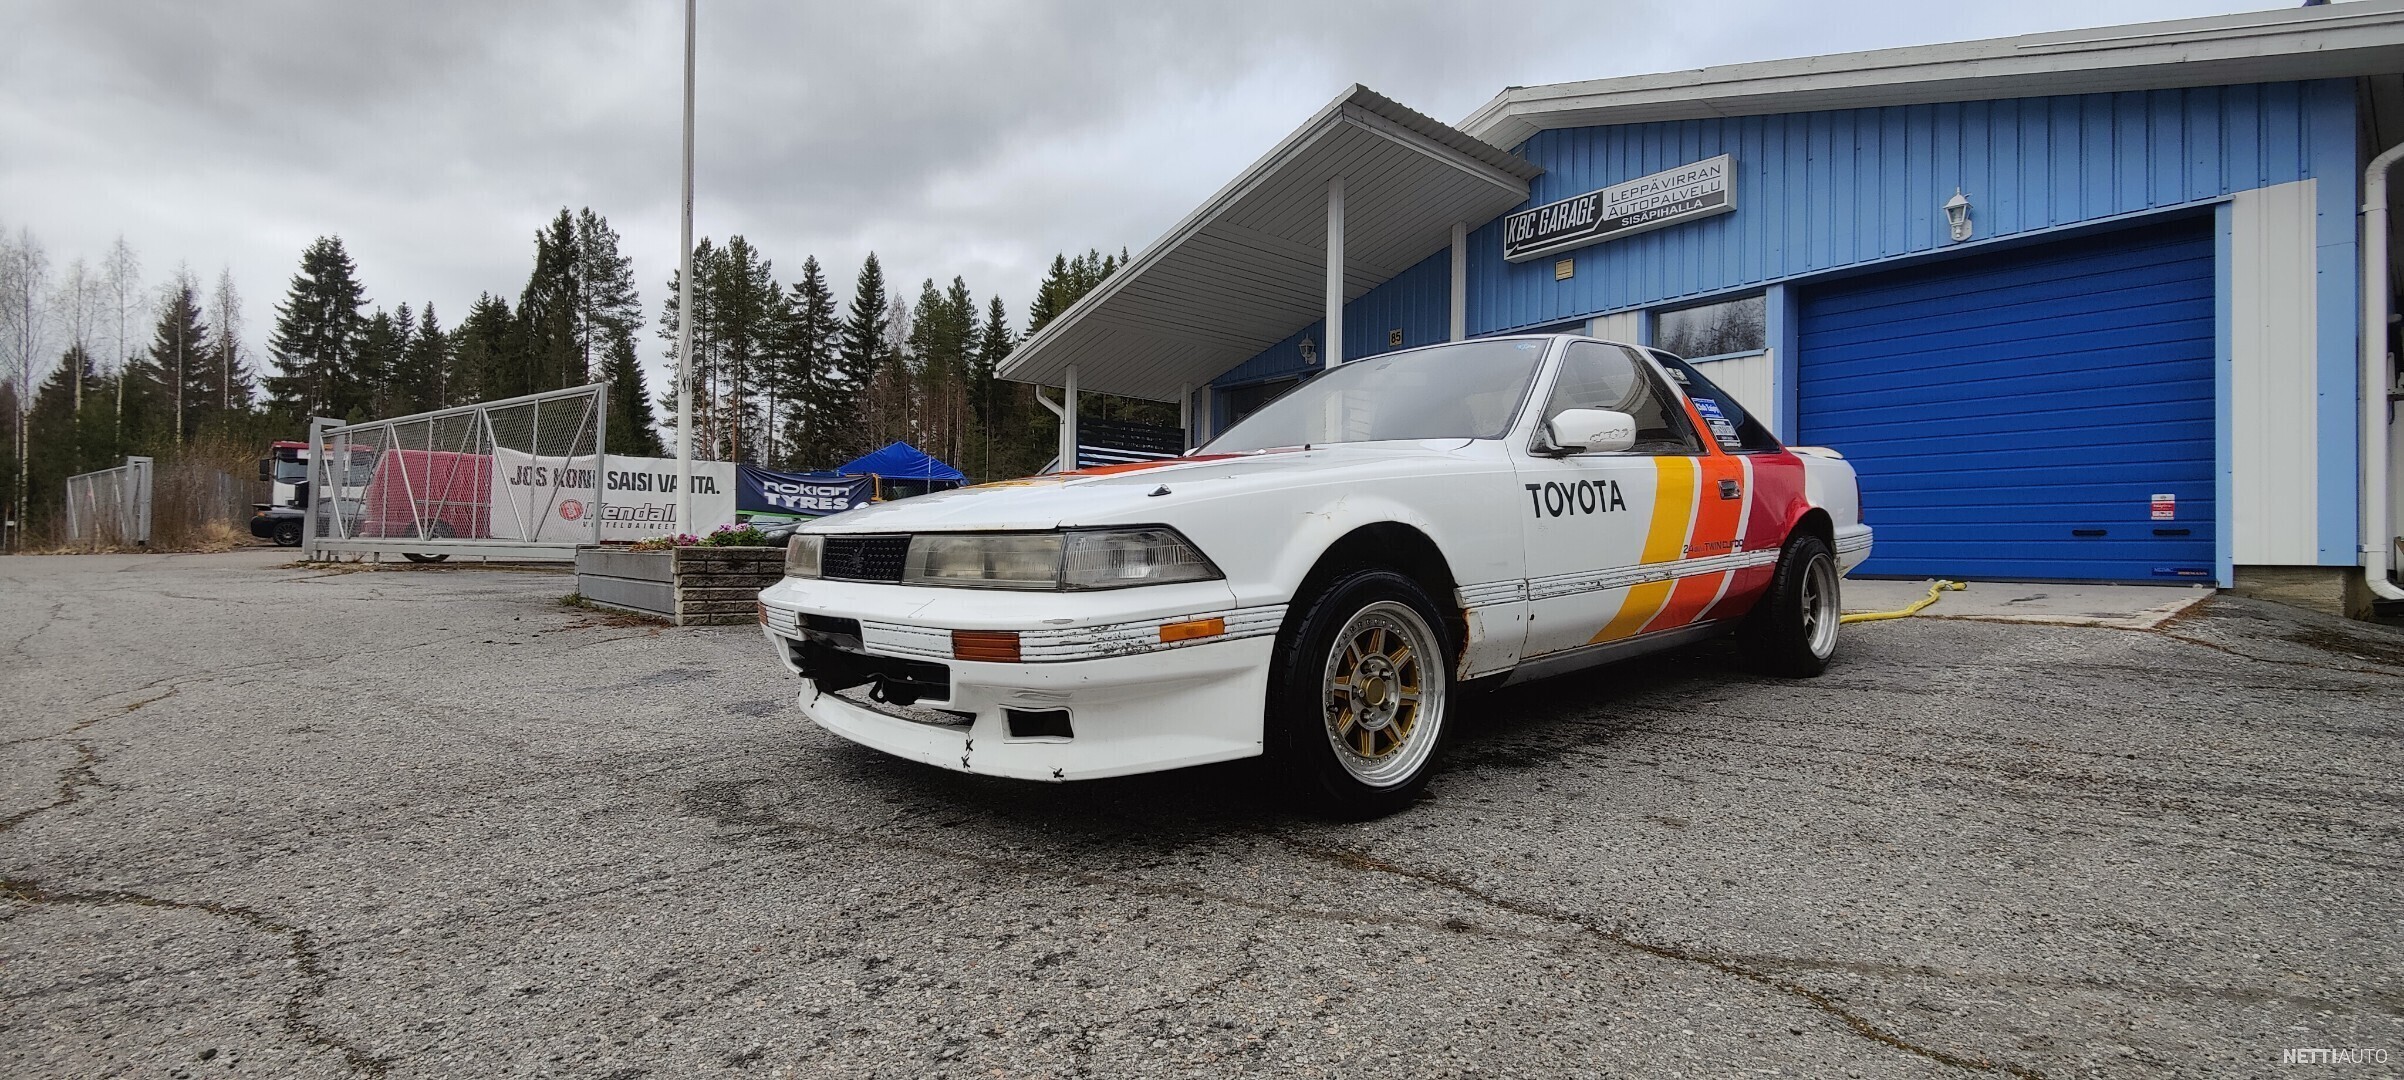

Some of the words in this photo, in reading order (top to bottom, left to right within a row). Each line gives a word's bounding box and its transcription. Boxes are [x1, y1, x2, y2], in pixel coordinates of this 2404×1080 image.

[1608, 180, 1721, 219] AUTOPALVELU
[1611, 164, 1721, 203] LEPPÄVIRRAN
[1507, 215, 1535, 244] KBC
[1538, 194, 1597, 236] GARAGE
[1621, 199, 1704, 227] SISÄPIHALLA
[1391, 331, 1401, 344] 85
[510, 465, 548, 487] JOS
[607, 470, 652, 492] SAISI
[657, 473, 721, 495] VAITA.
[764, 492, 849, 510] TYRES
[1525, 479, 1627, 519] TOYOTA
